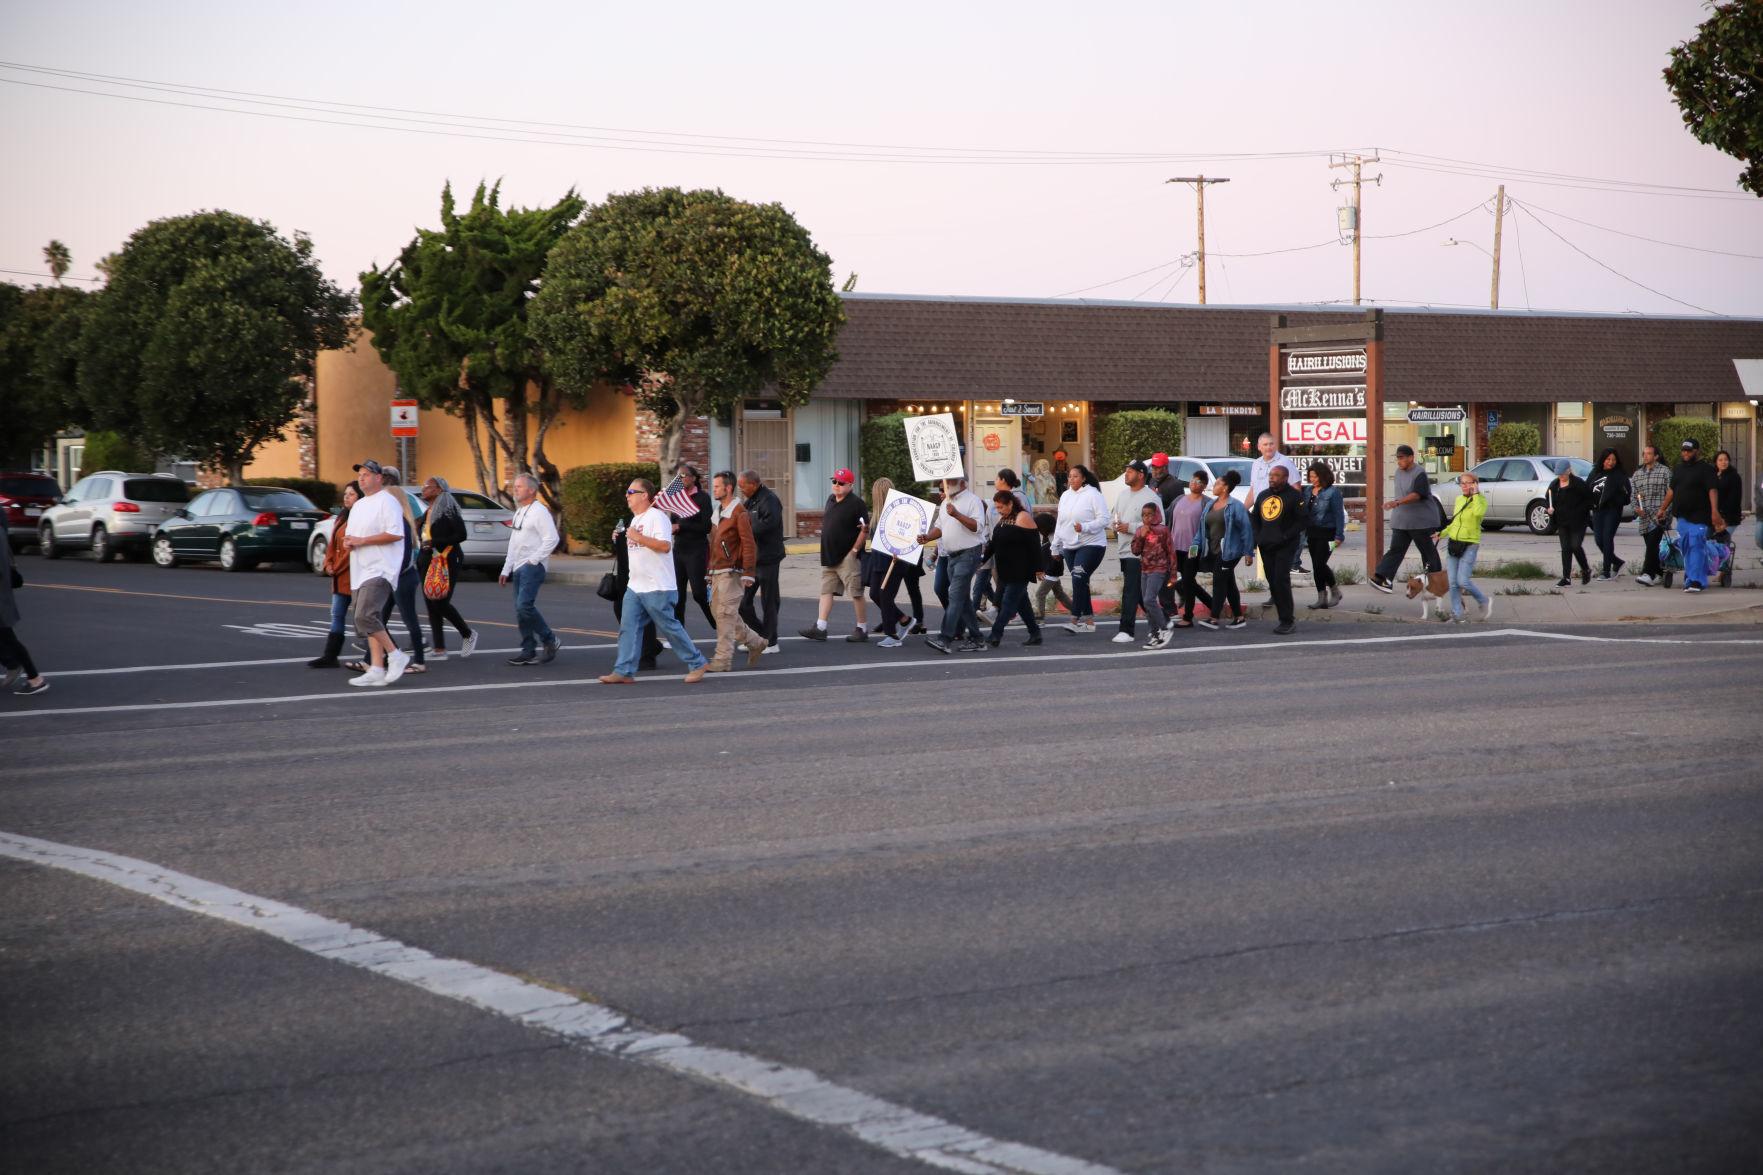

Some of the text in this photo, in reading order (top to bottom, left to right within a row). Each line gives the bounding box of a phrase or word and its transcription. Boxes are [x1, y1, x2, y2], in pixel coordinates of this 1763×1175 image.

[1289, 355, 1366, 370] HAIRILLUSIONS
[1285, 388, 1365, 409] McKenna's
[1023, 404, 1040, 414] Sweet
[1221, 407, 1257, 415] TIENDITA
[1411, 411, 1462, 420] HAIRILLUSIONS
[1286, 421, 1367, 441] LEGAL
[1292, 458, 1363, 471] UST SWEET
